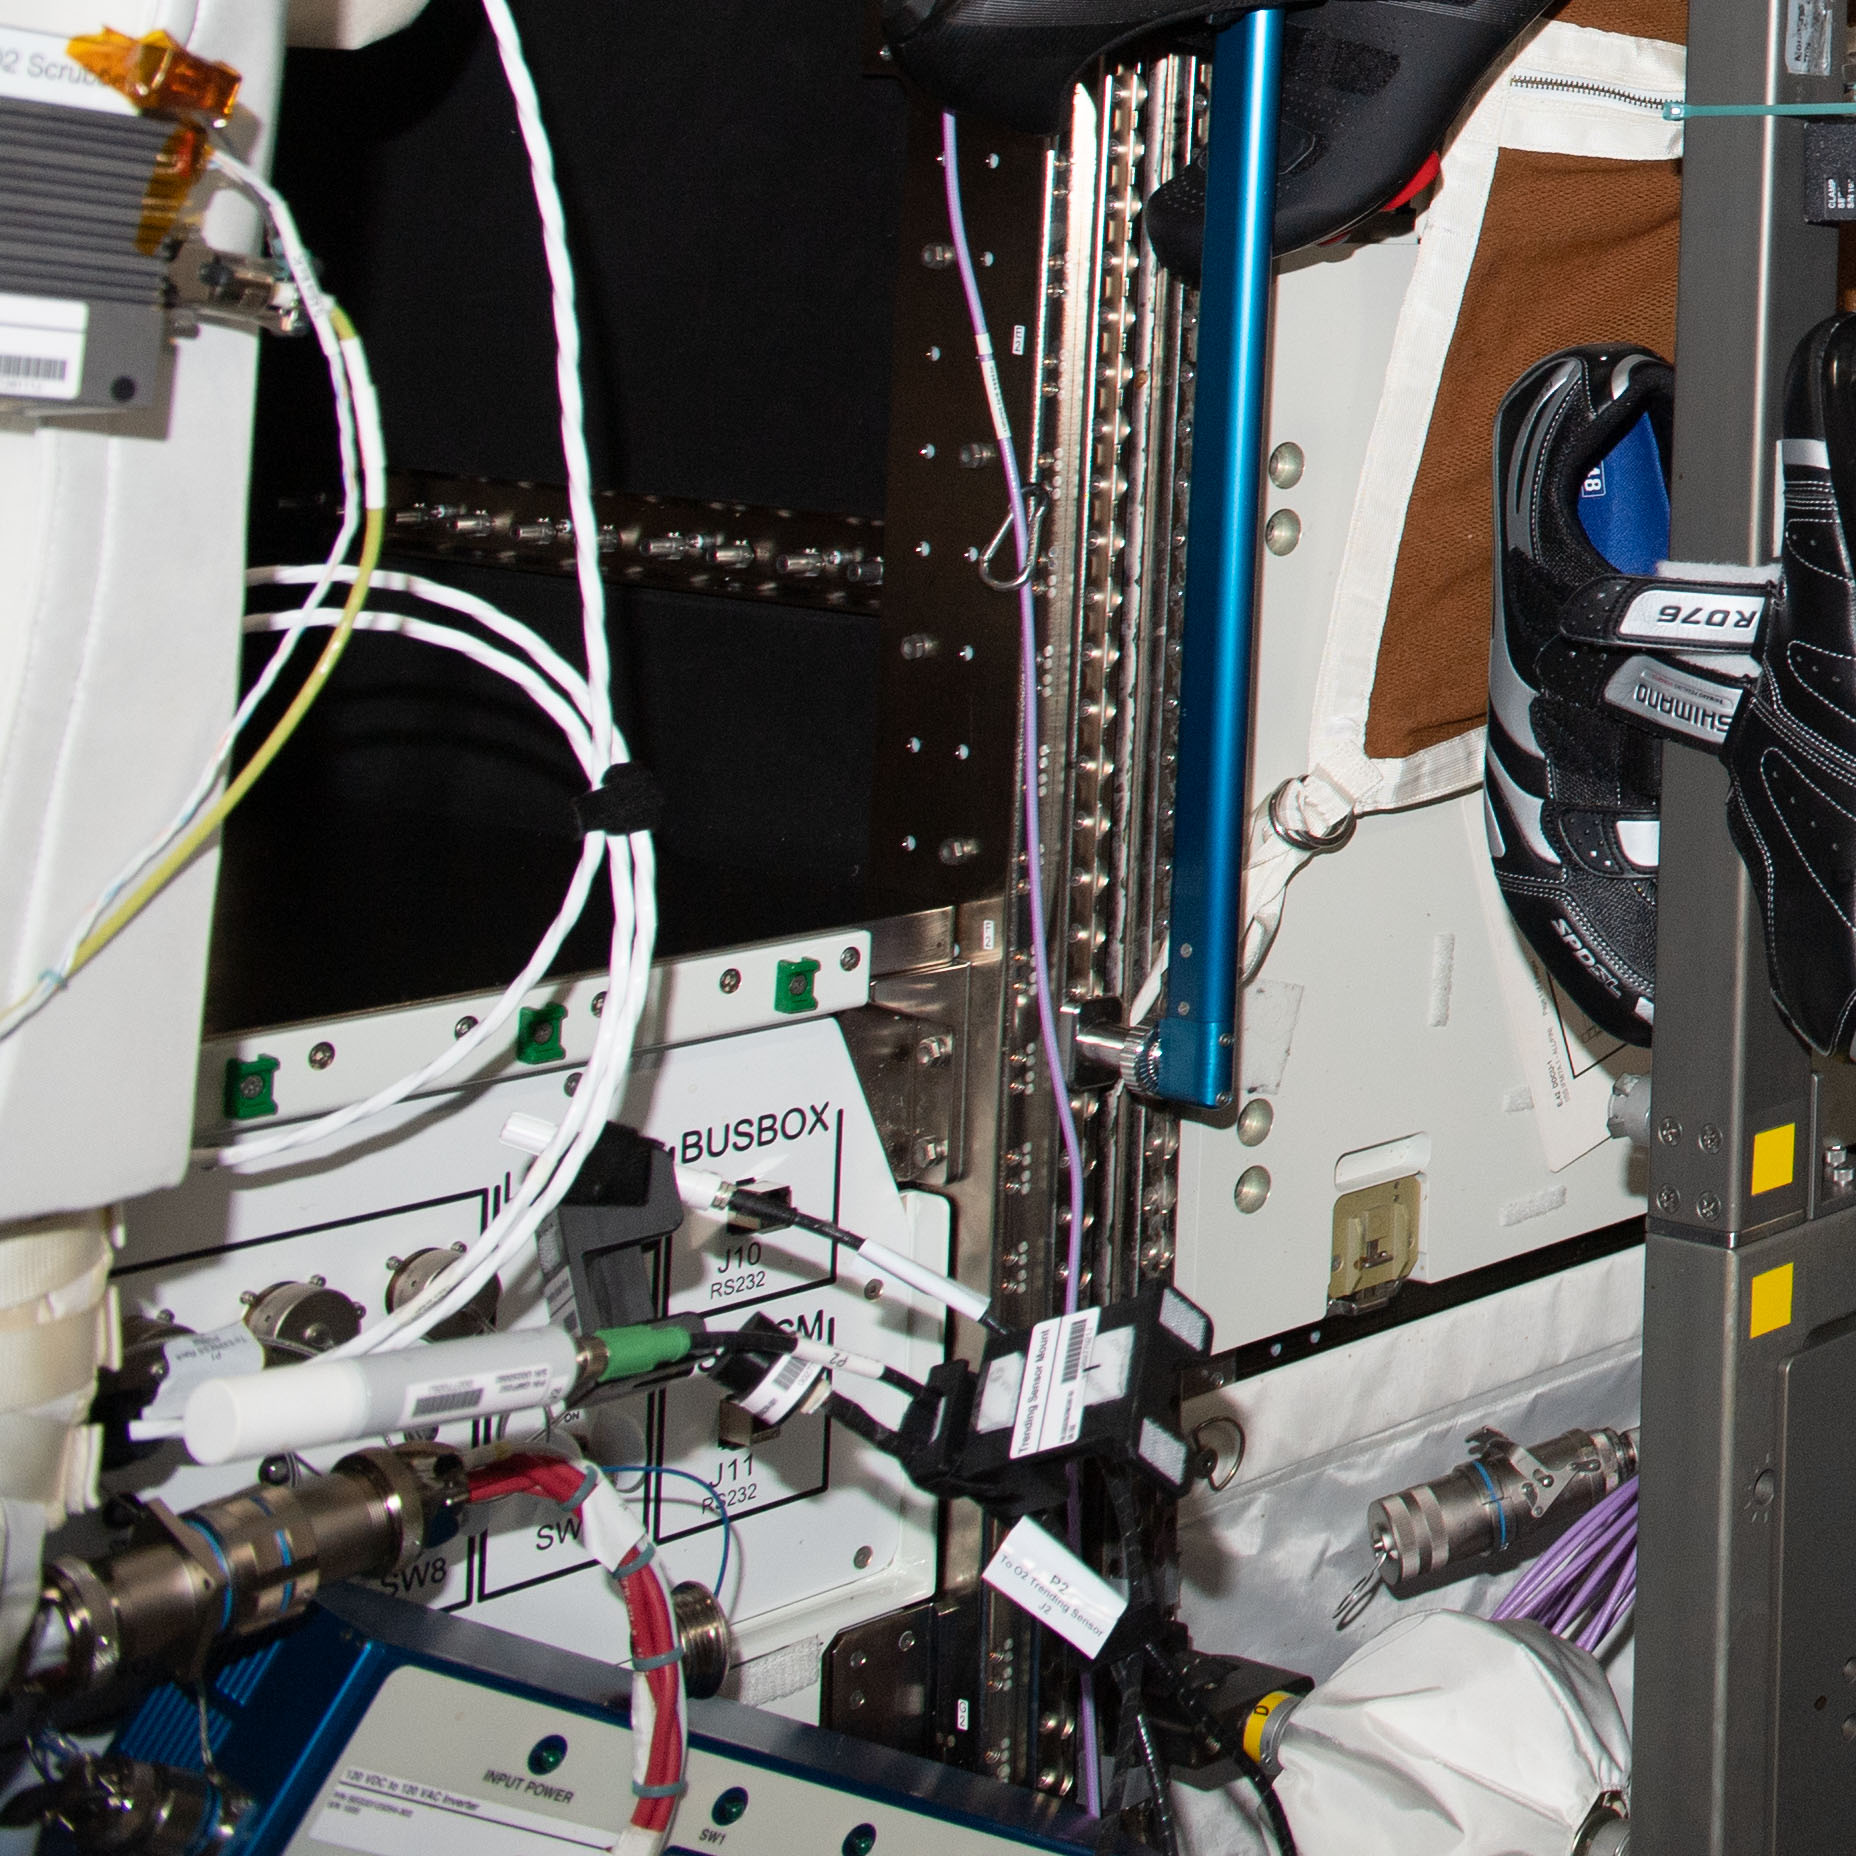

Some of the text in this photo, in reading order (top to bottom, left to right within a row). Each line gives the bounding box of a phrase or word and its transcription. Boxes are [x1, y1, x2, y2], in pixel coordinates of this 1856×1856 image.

[1656, 605, 1759, 629] RD76
[1634, 682, 1734, 733] SHIMANO
[681, 1101, 830, 1165] BUSBOX
[716, 1241, 762, 1274] J10
[710, 1271, 766, 1300] RS232
[708, 1454, 755, 1489] J11
[701, 1483, 758, 1515] RS232
[381, 1556, 447, 1597] SW8
[1049, 1574, 1069, 1596] P2
[999, 1554, 1014, 1569] To
[1029, 1577, 1070, 1613] Trending
[1070, 1608, 1104, 1637] Sensor
[1038, 1603, 1053, 1616] J2
[483, 1768, 575, 1804] INPUT POWER
[699, 1828, 727, 1845] SW1
